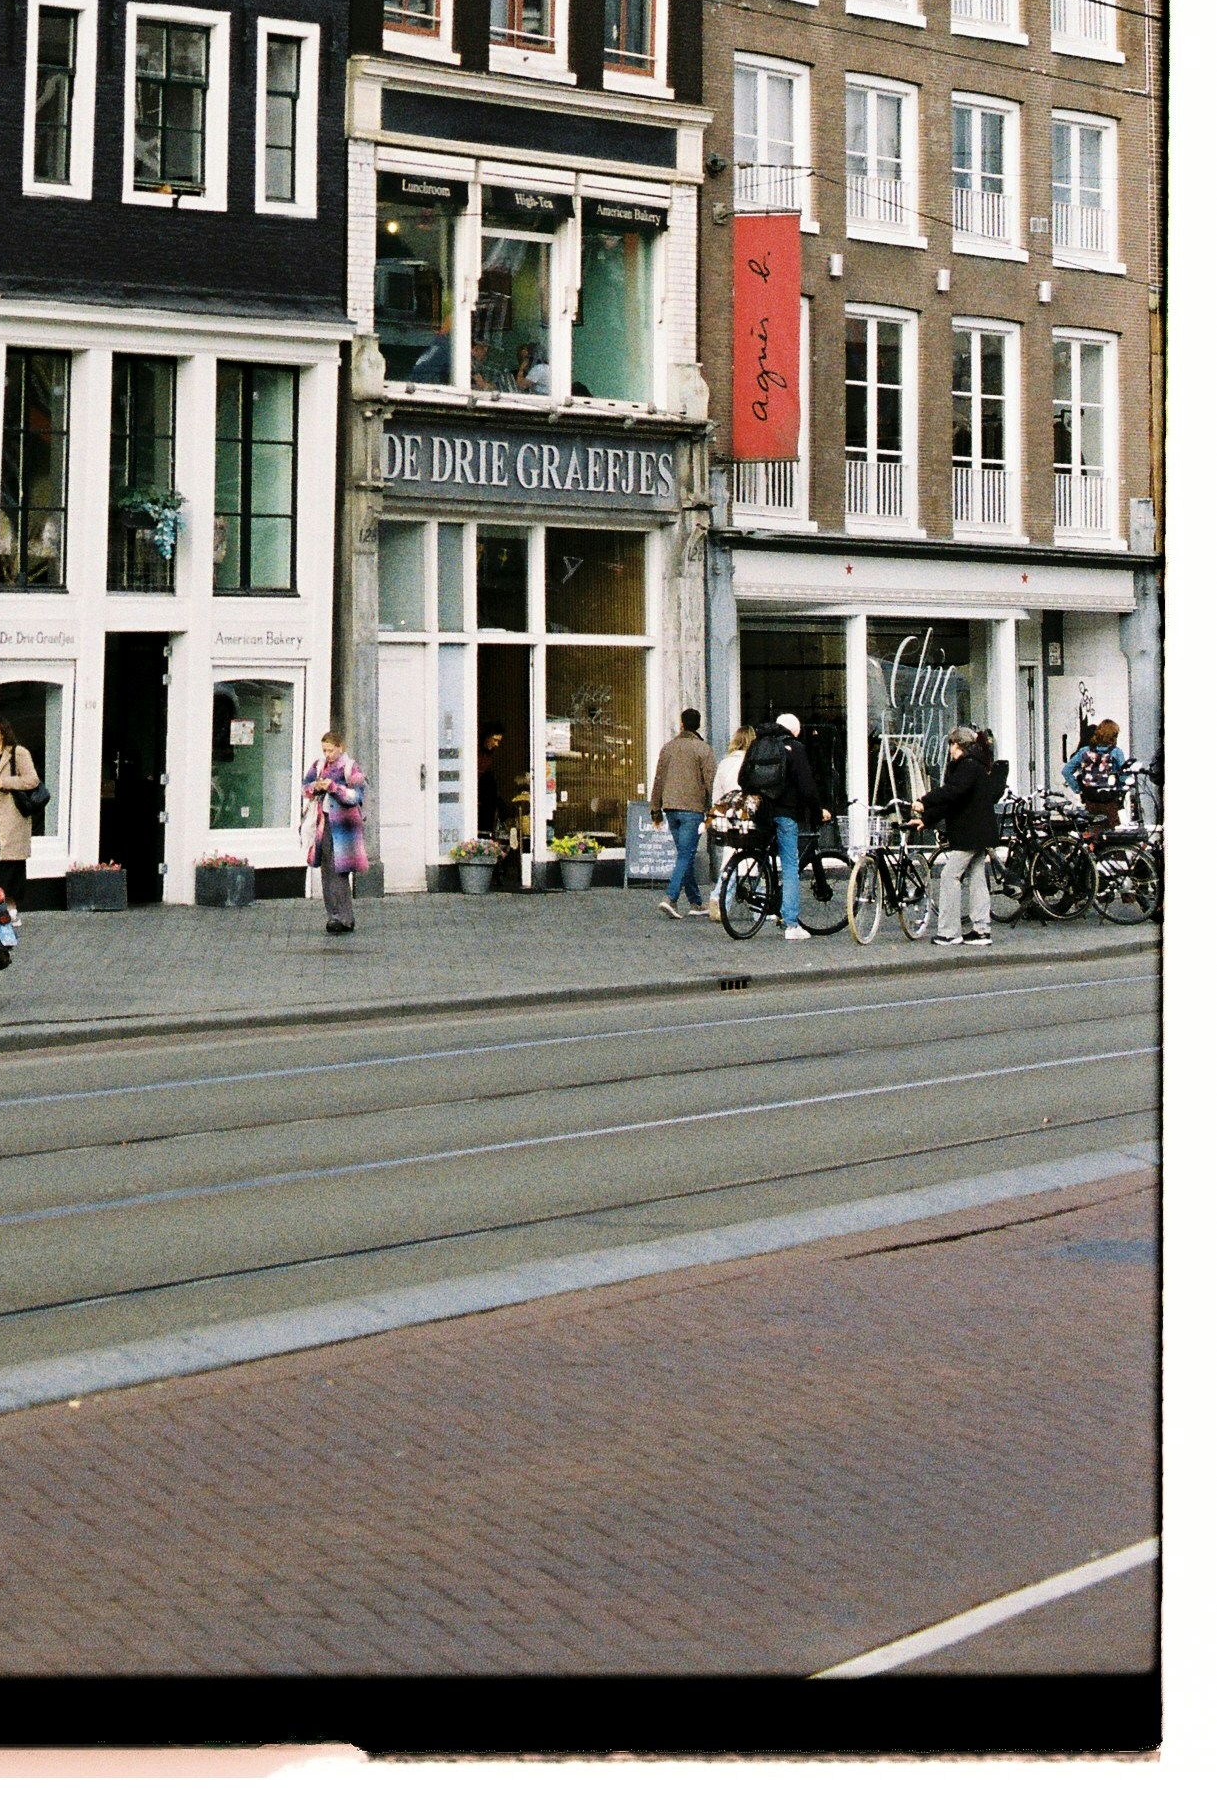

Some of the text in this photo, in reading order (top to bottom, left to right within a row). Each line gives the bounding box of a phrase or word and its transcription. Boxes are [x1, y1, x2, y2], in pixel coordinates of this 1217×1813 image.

[402, 178, 451, 197] Lunchroom
[515, 192, 554, 209] High-Tea
[596, 204, 661, 226] American Bakery
[382, 432, 674, 498] DE DRIE GRAEFJES
[0, 631, 13, 644] De
[16, 631, 34, 644] Drie
[215, 631, 303, 651] American Bakery
